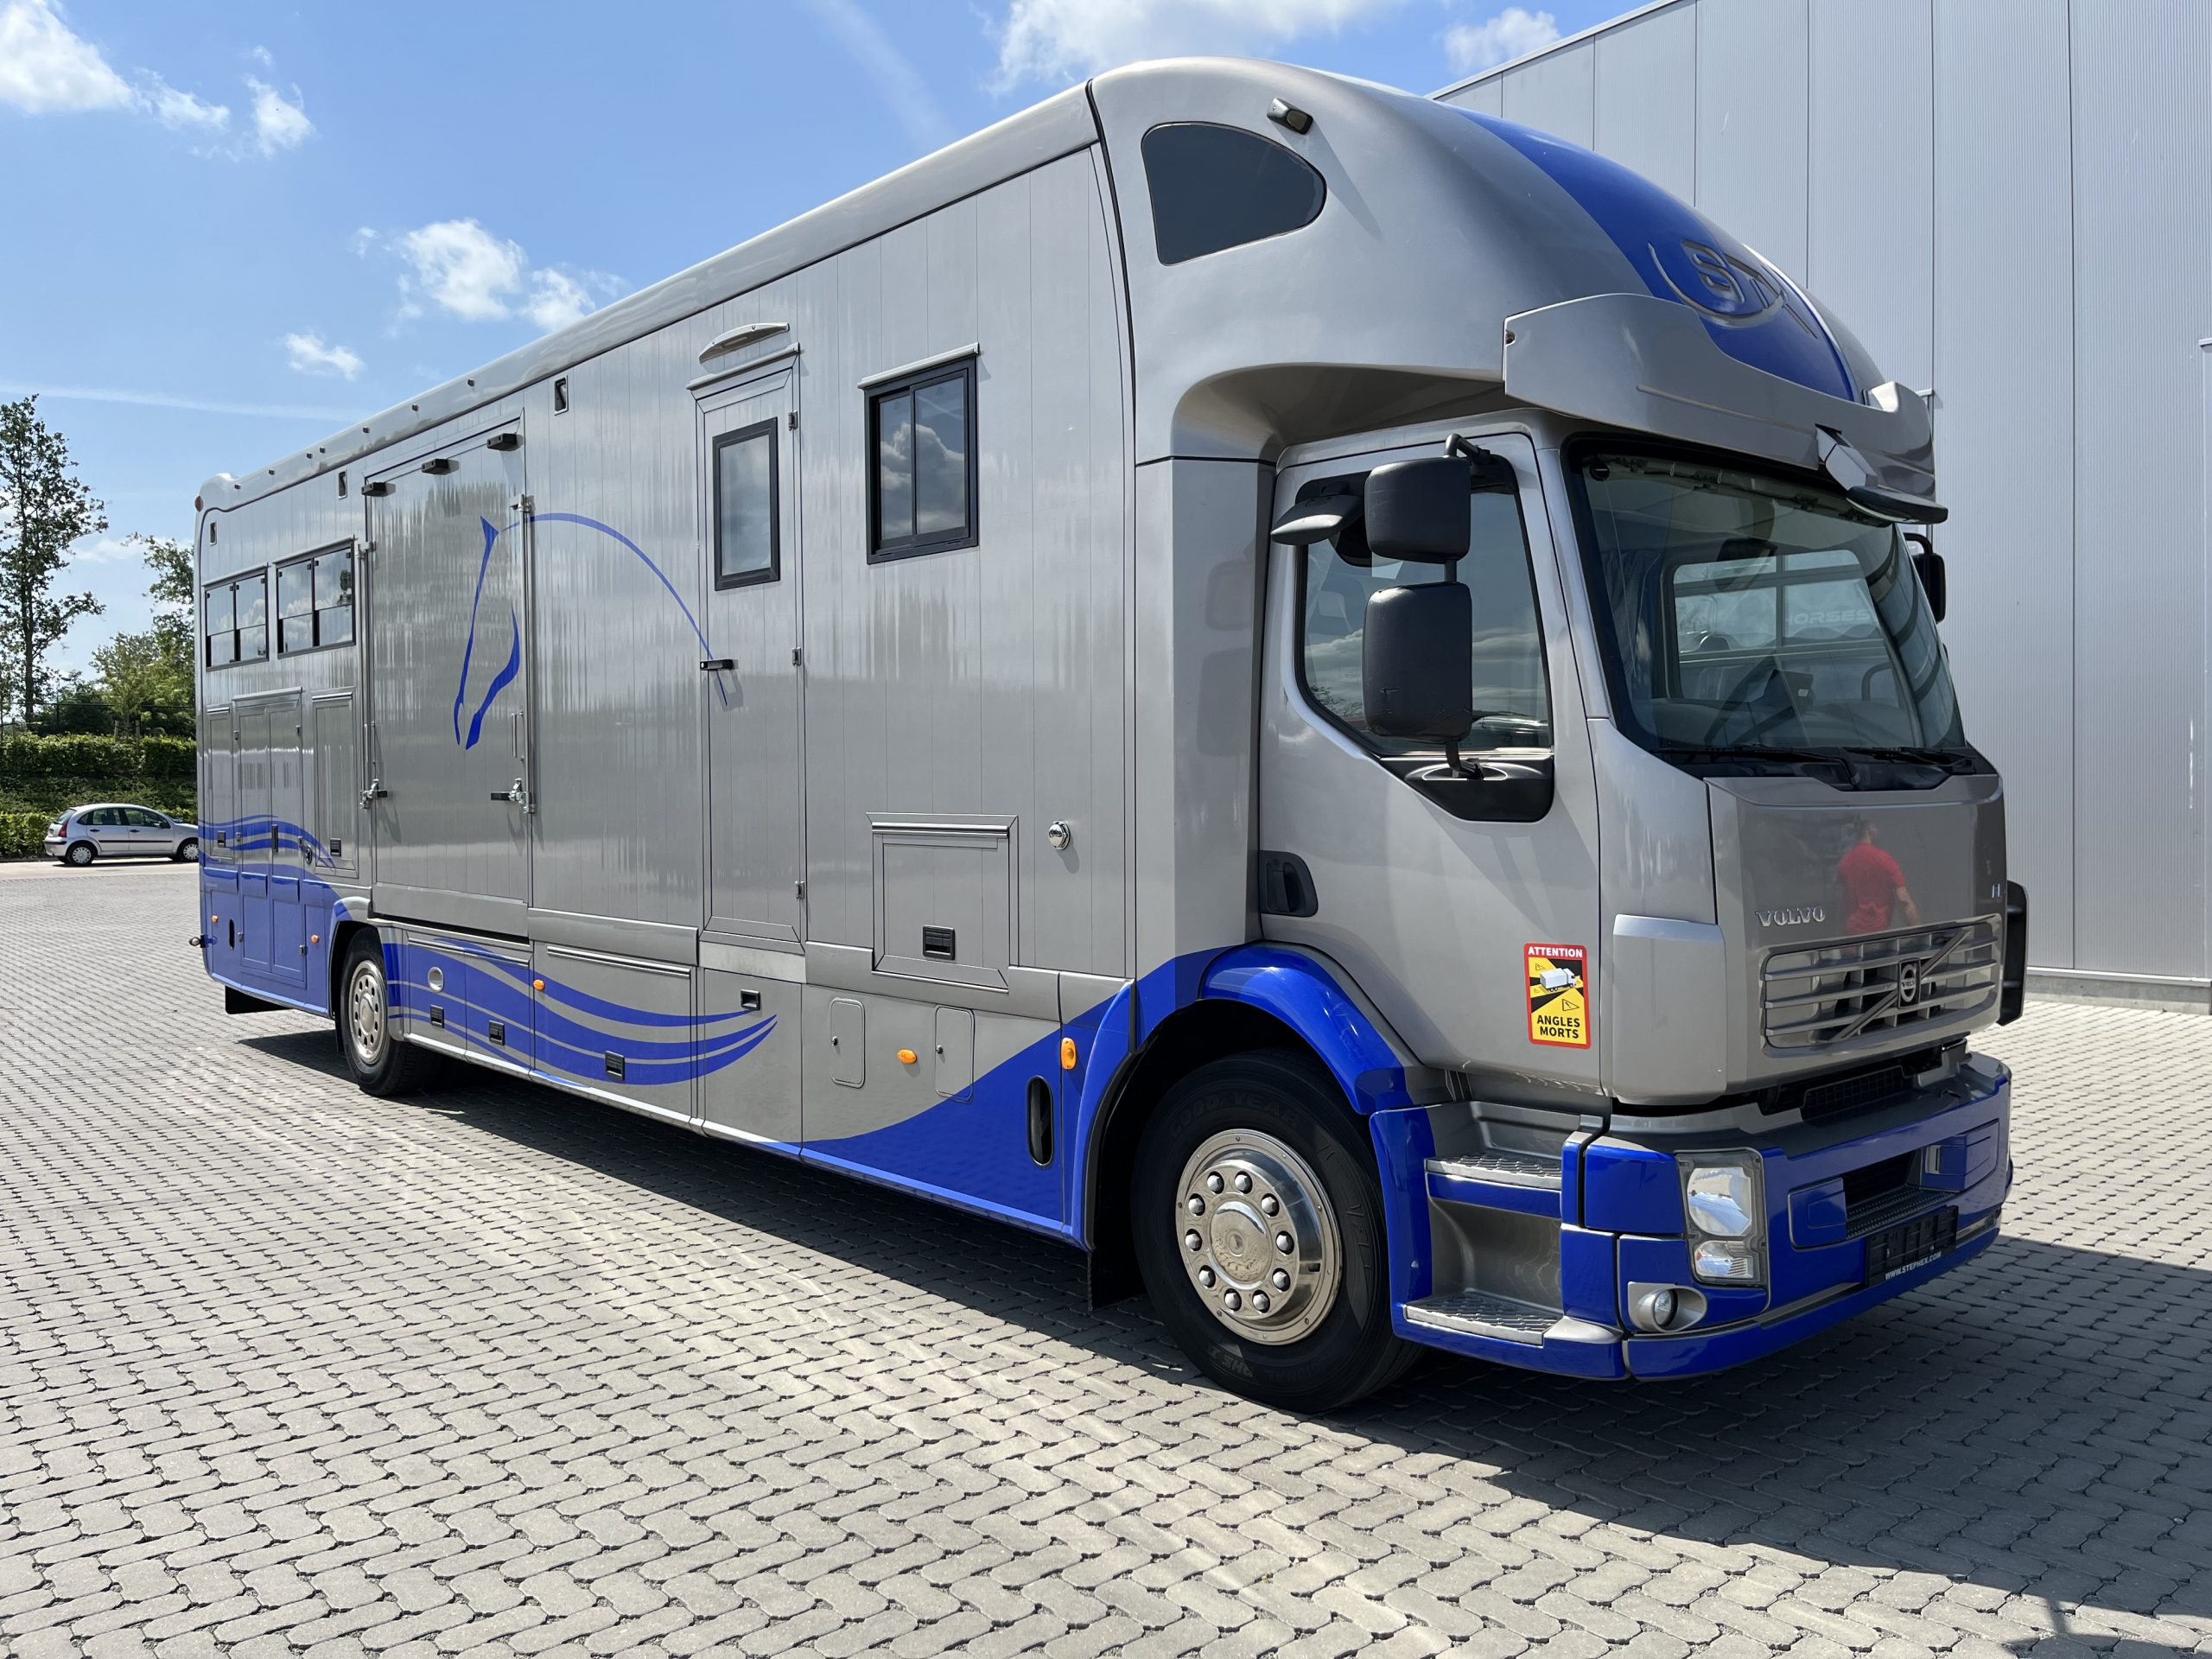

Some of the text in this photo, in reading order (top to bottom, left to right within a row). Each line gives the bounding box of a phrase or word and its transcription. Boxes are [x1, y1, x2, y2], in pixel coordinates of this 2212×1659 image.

[1755, 906, 1826, 927] VOLVO
[1528, 946, 1583, 958] ATTENTION
[1537, 1014, 1580, 1027] ANGLES
[1540, 1026, 1579, 1039] MORTS
[1885, 1250, 1942, 1281] WWW.STEPHEX.COM
